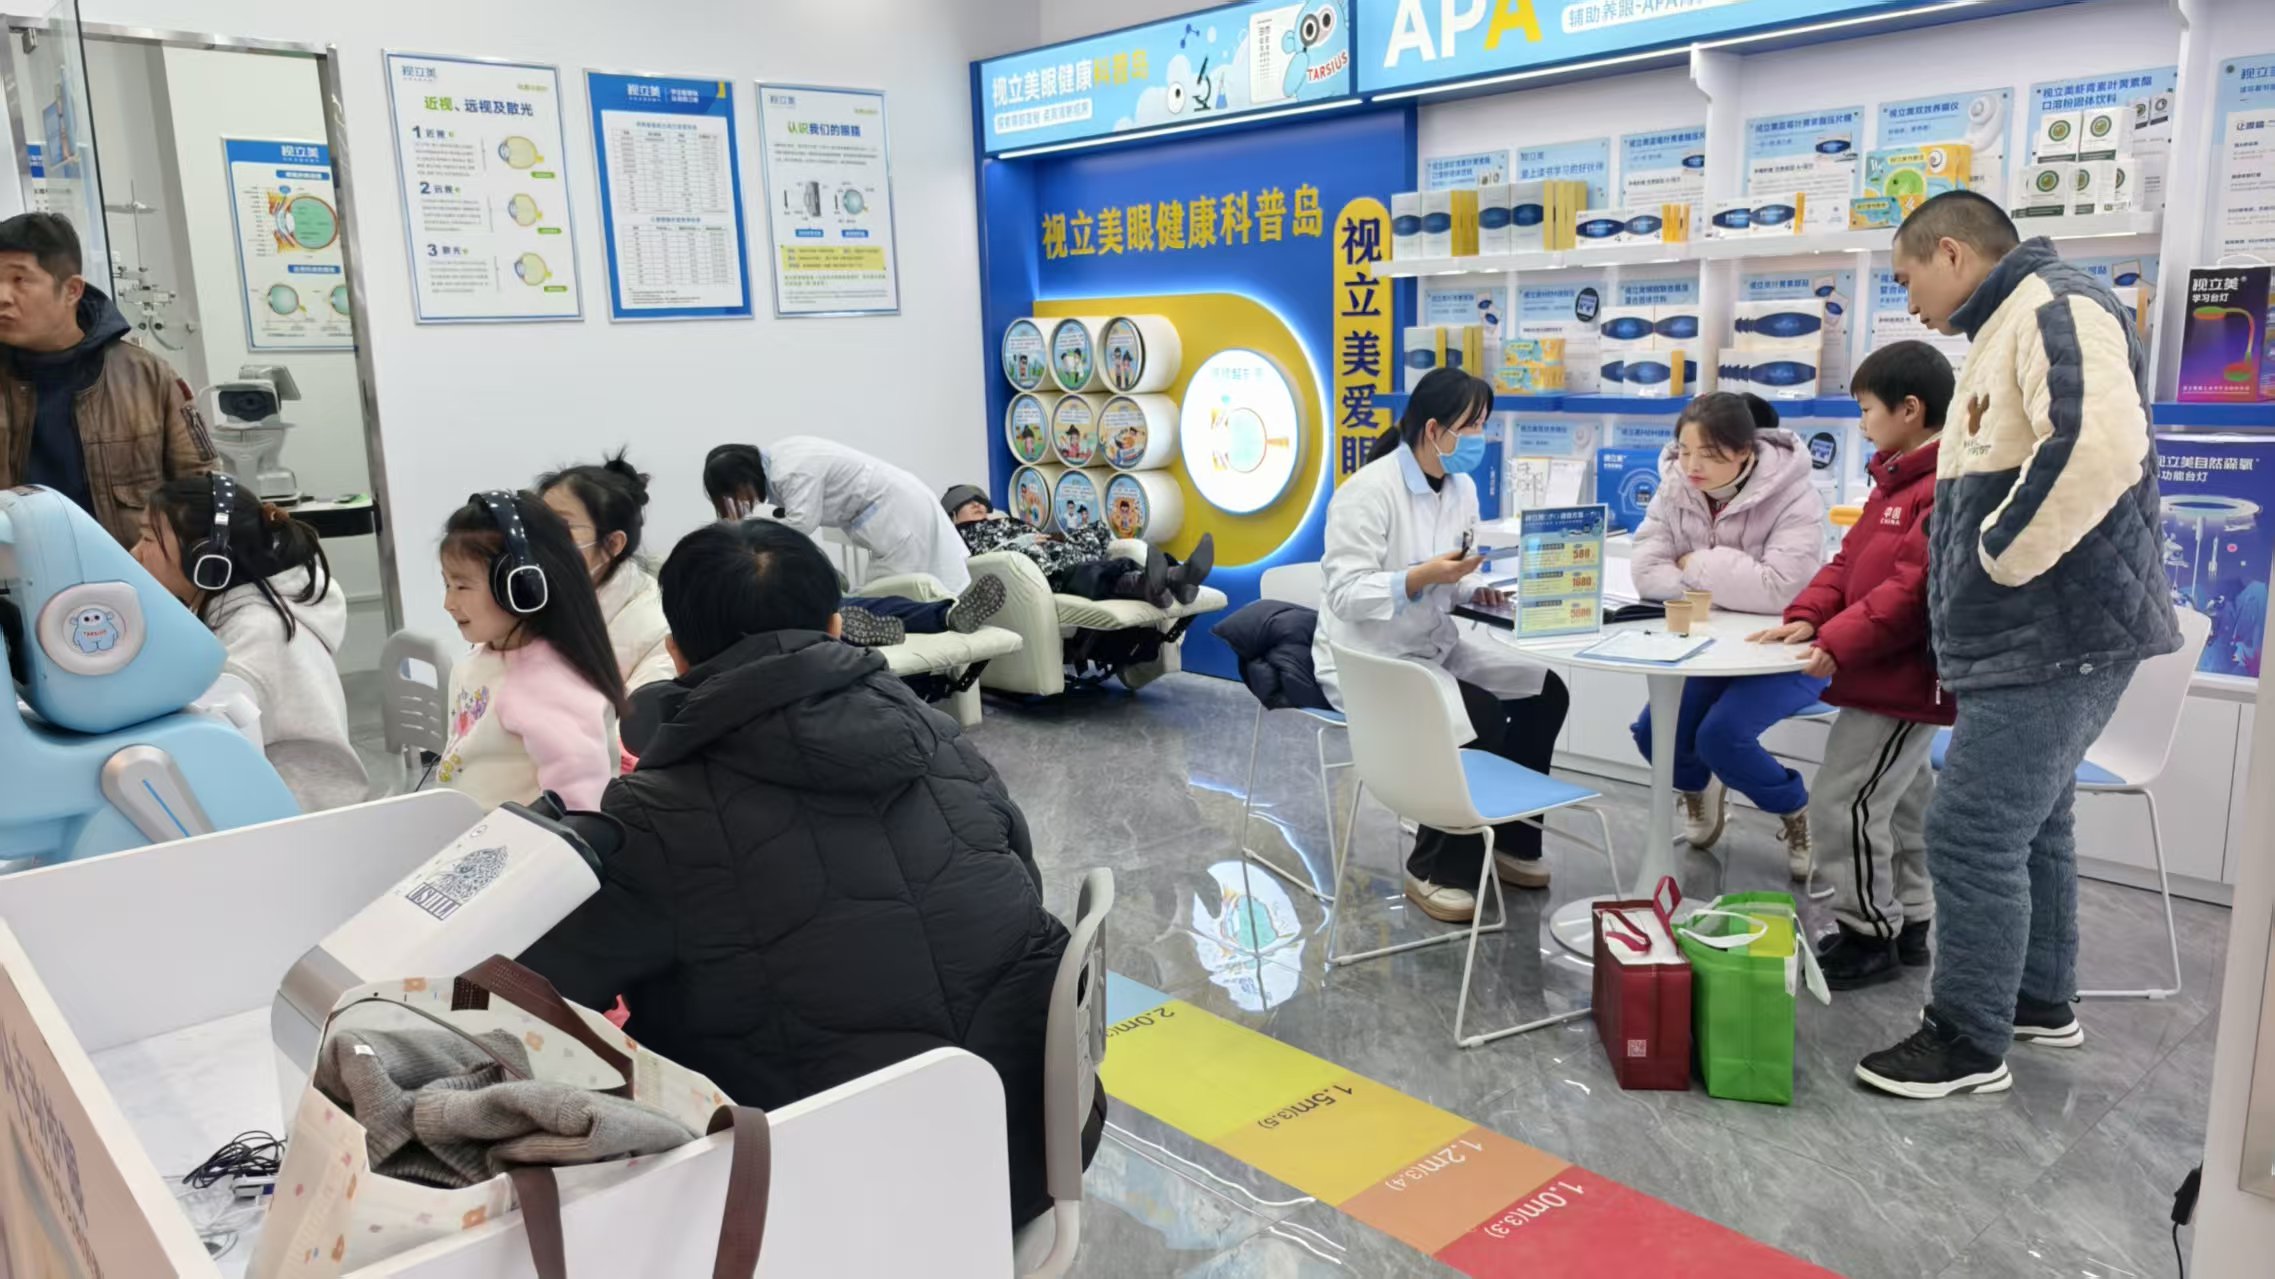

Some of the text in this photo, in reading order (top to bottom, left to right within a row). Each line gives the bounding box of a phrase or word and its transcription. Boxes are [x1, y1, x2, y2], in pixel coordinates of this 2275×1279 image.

[1383, 0, 1543, 68] APA
[1306, 51, 1349, 82] TARSIUS
[424, 96, 535, 117] 近视、远视及散光
[411, 125, 421, 139] 1
[420, 181, 431, 195] 2
[1043, 183, 1325, 261] 视立美眼健康科普岛
[427, 243, 438, 257] 3
[2192, 277, 2240, 292] 视立美
[2192, 292, 2229, 304] 学习台灯
[2157, 470, 2209, 483] 功能台灯
[1257, 1084, 1353, 1130] 1.5m(3.5)
[1385, 1138, 1483, 1192] 1.2m(3.4)
[1484, 1180, 1584, 1239] 1.0m(3.3)
